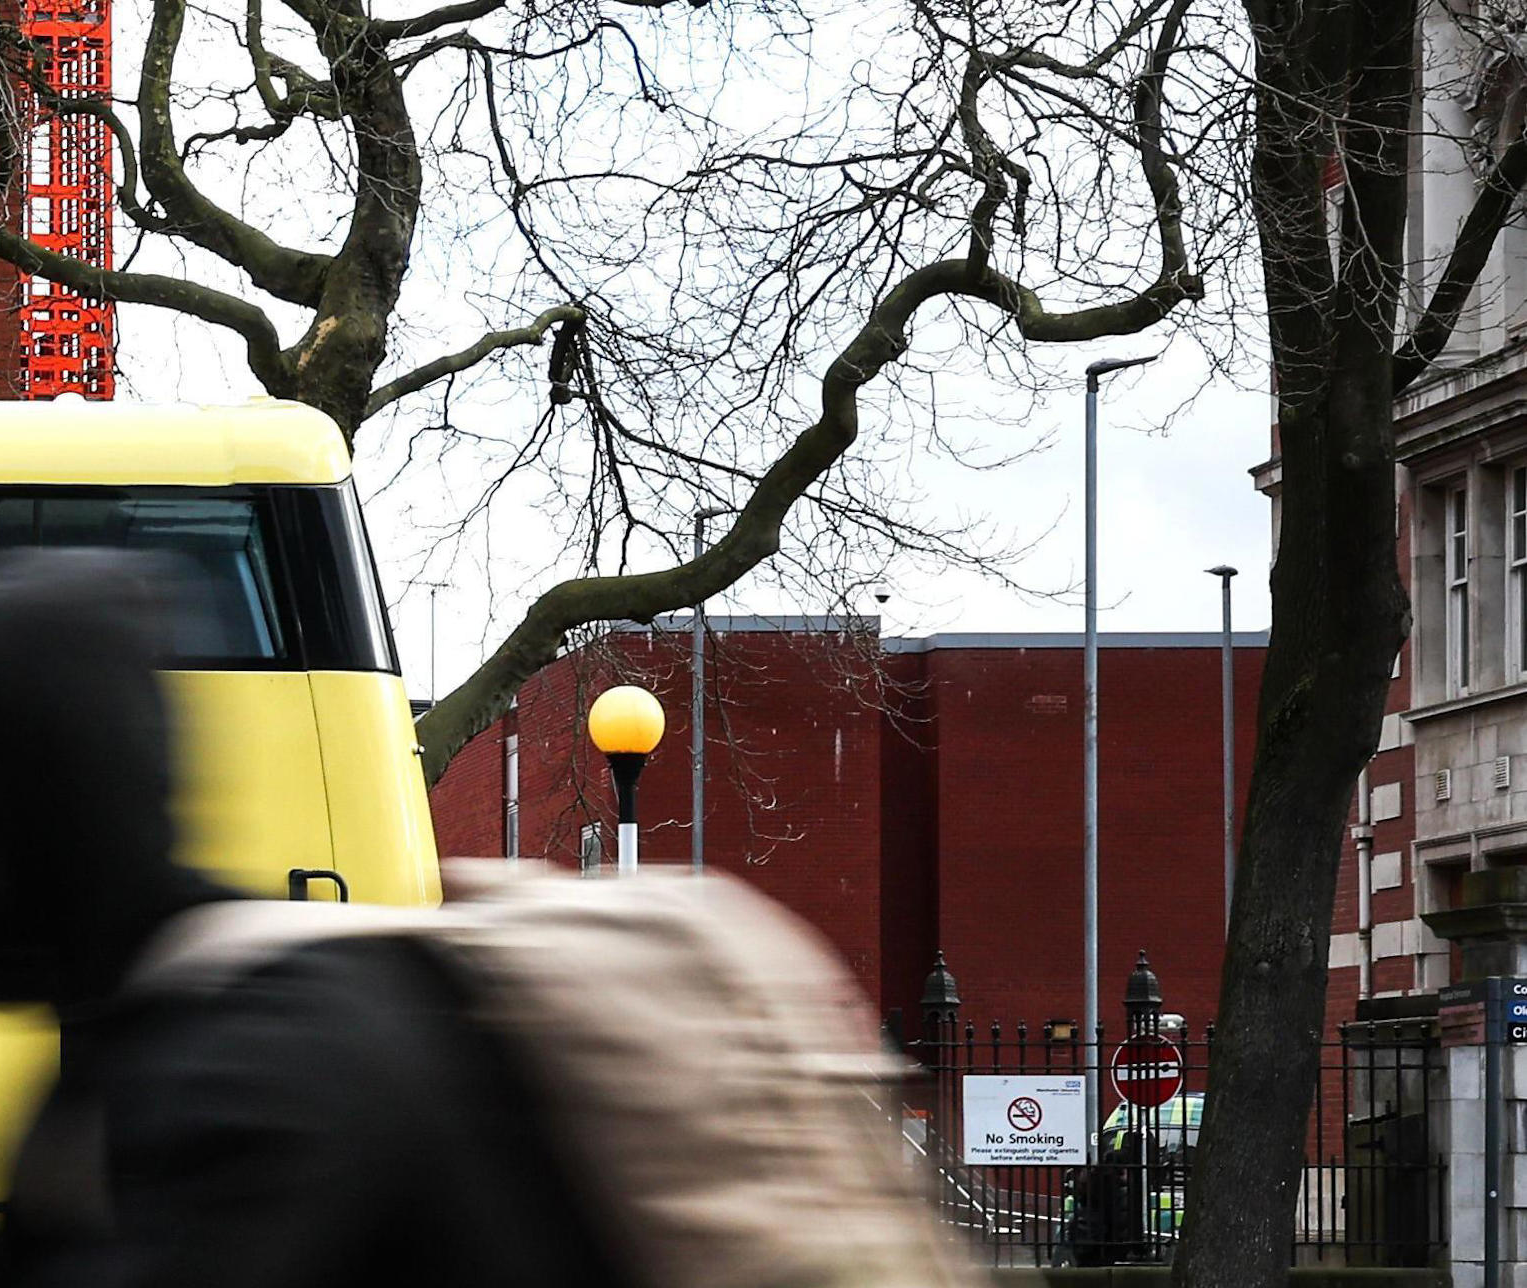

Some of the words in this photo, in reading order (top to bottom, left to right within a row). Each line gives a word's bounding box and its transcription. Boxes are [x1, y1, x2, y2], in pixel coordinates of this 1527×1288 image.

[1512, 1026, 1527, 1038] Ci
[986, 1133, 1003, 1144] No
[1009, 1133, 1064, 1147] Smoking
[1049, 1147, 1079, 1155] cigarette
